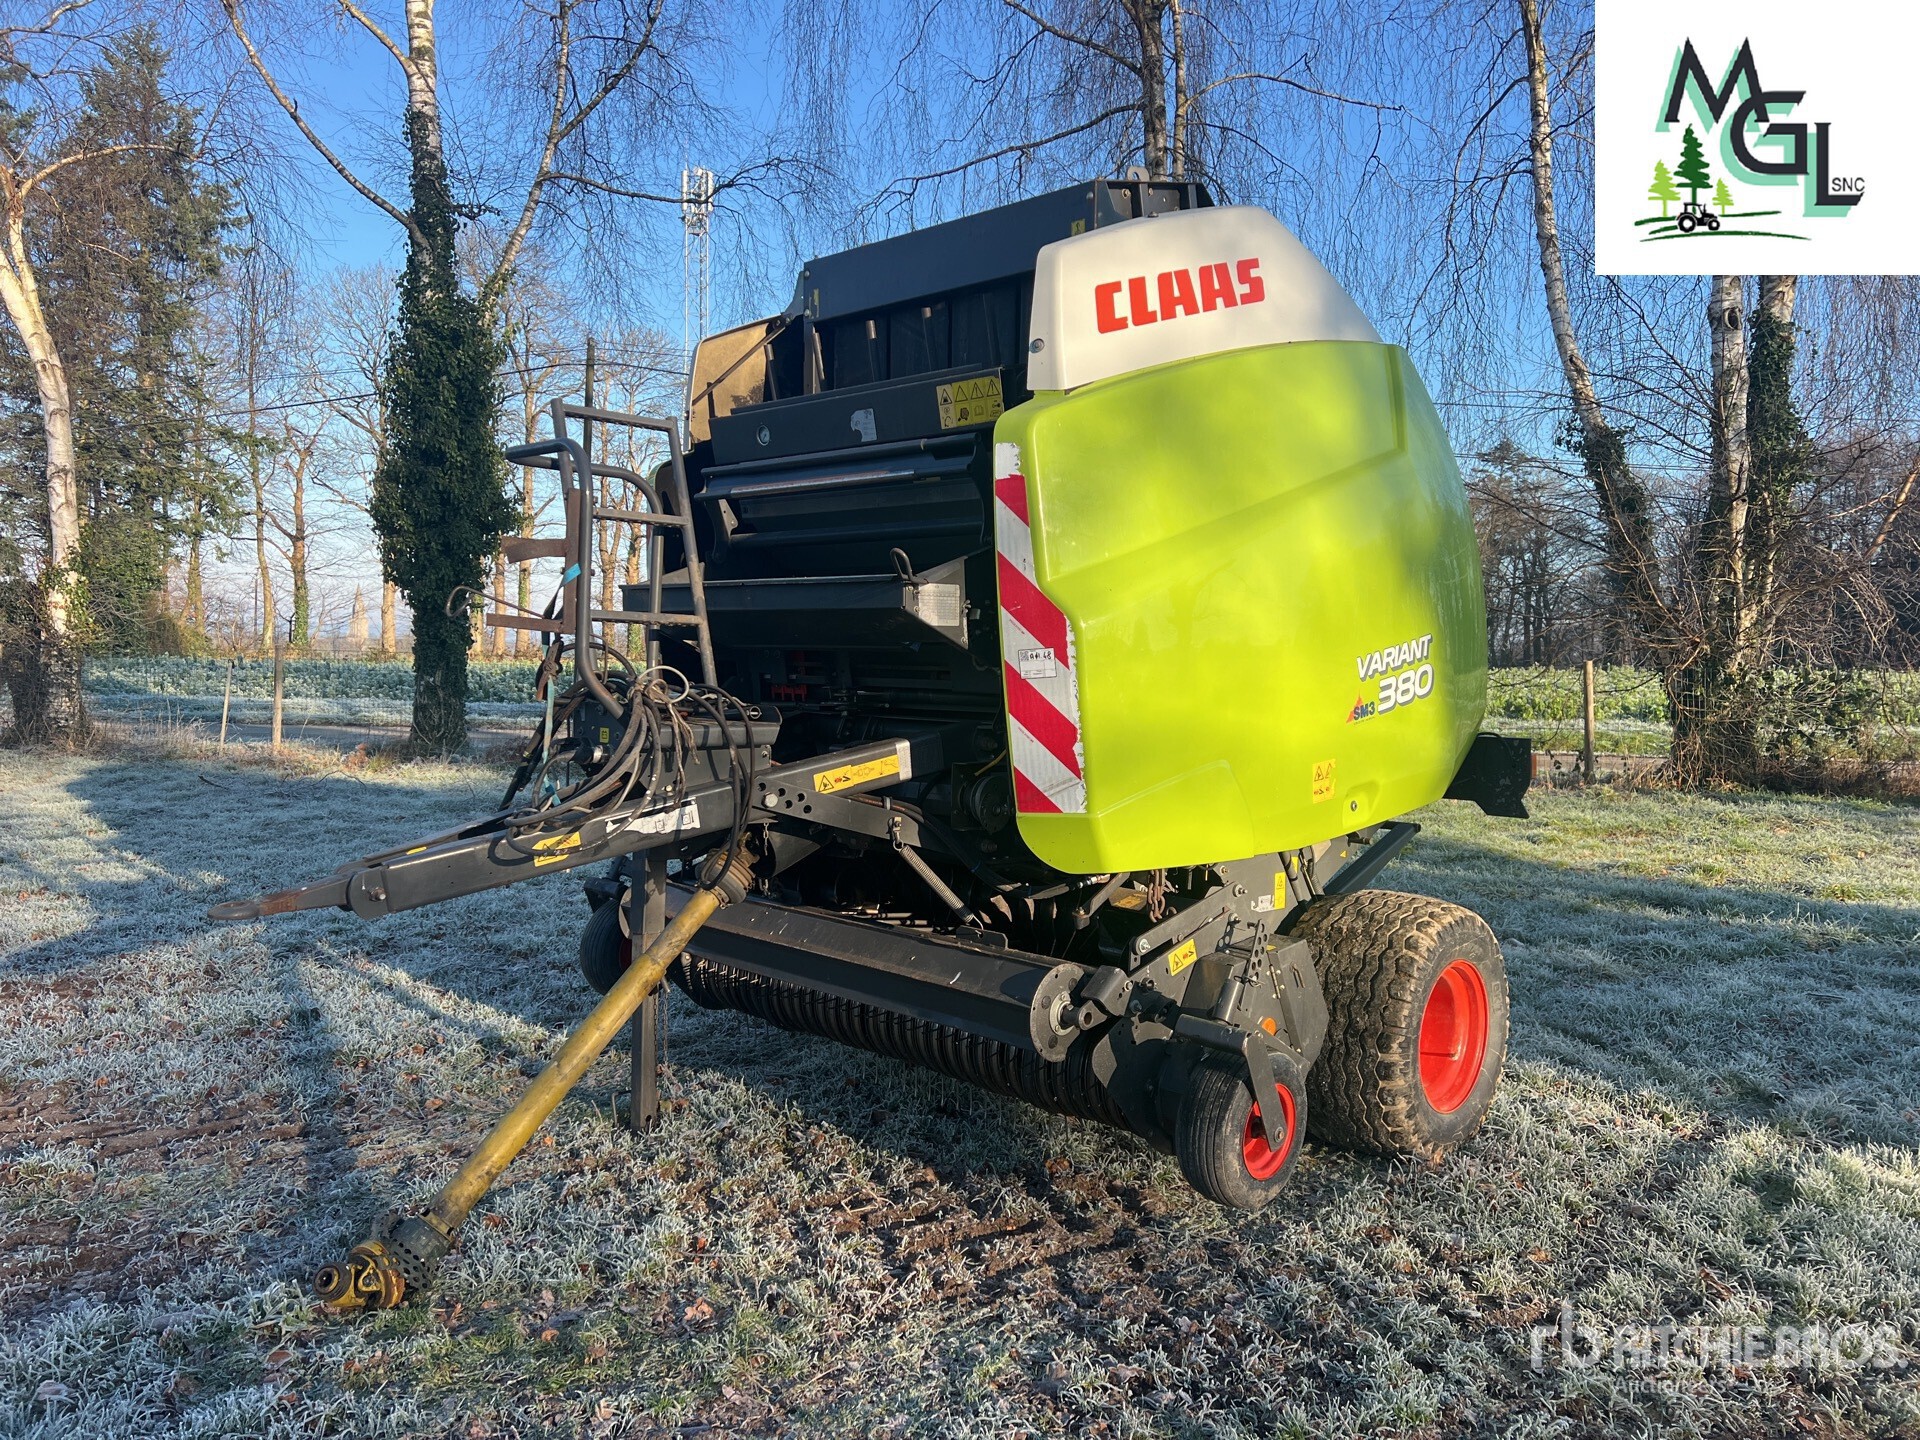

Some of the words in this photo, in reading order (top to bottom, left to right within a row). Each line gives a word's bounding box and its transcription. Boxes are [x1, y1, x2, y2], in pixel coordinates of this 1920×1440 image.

[1095, 257, 1265, 334] CLAAS
[1356, 633, 1433, 682] VARIANT
[1353, 701, 1375, 720] SM3
[1377, 663, 1435, 715] 380
